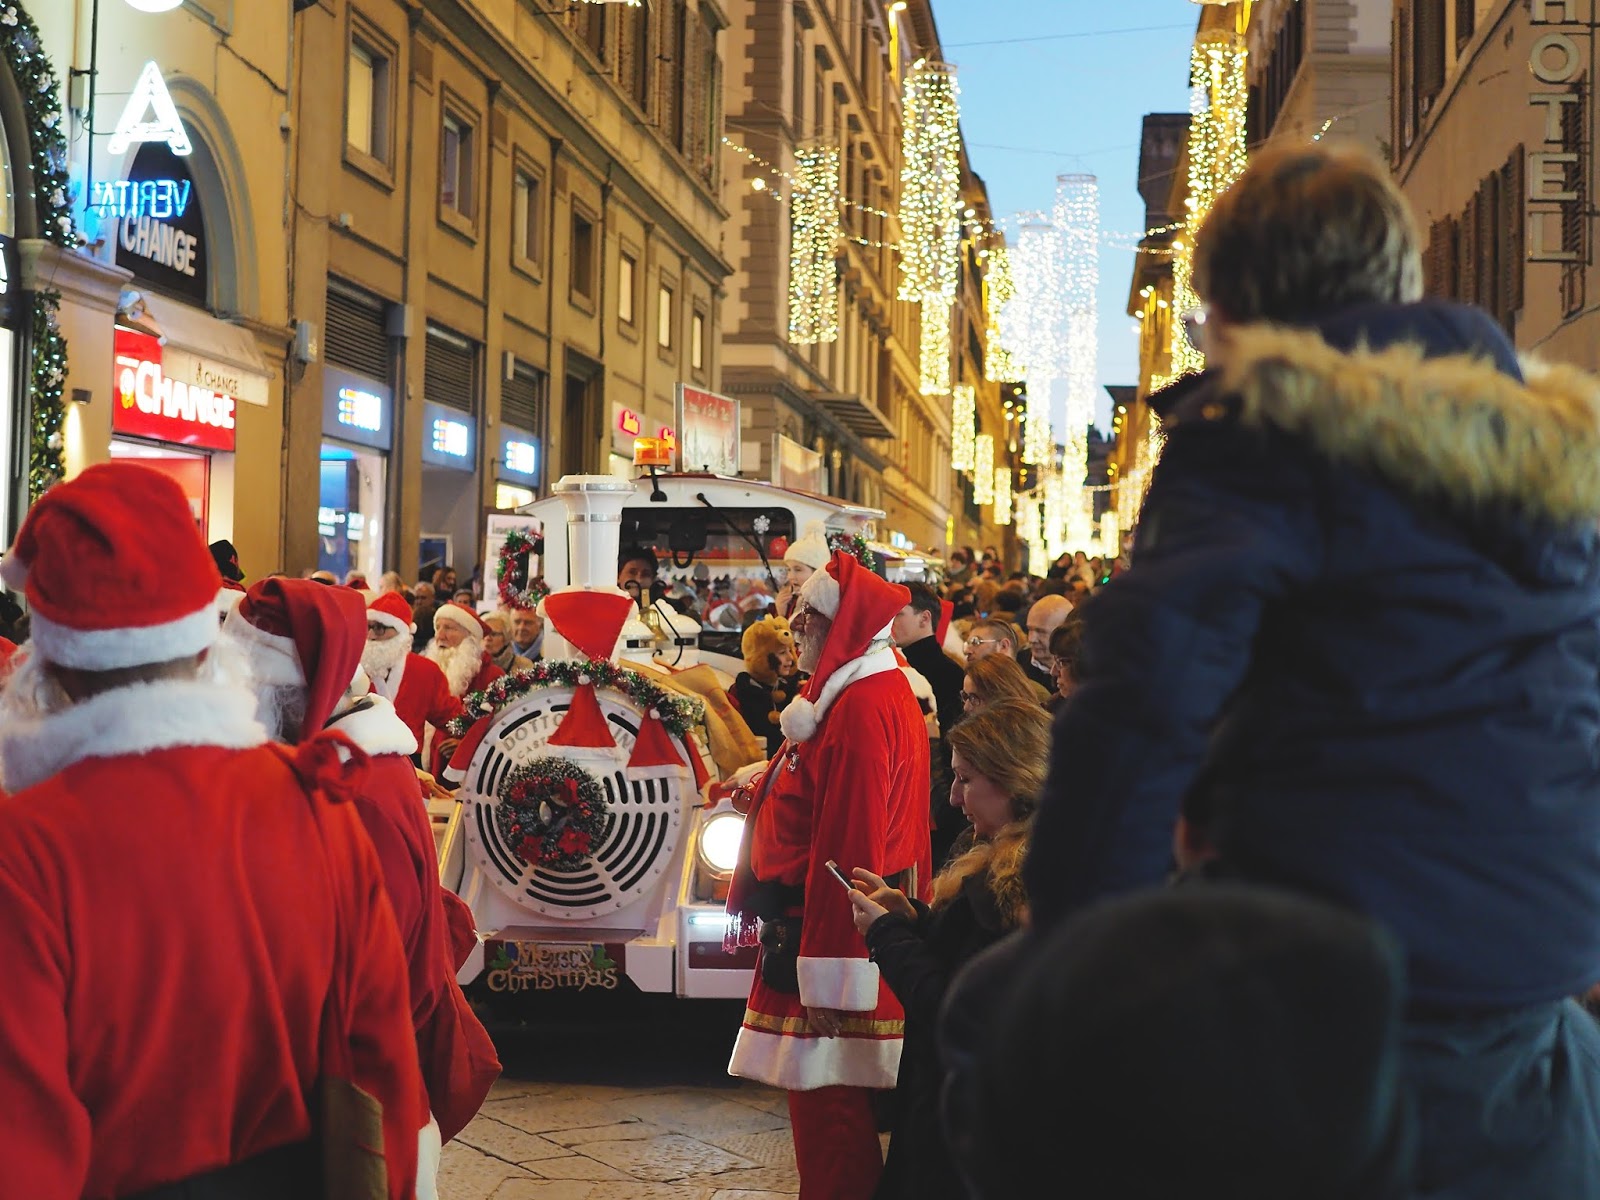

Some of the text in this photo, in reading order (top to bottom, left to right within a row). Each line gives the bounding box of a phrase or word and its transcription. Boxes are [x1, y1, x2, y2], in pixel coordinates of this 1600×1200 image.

[107, 60, 192, 156] A
[121, 210, 197, 277] CHANGE
[204, 371, 238, 395] CHANGE
[511, 941, 595, 970] Merry
[487, 966, 618, 994] Christmas
